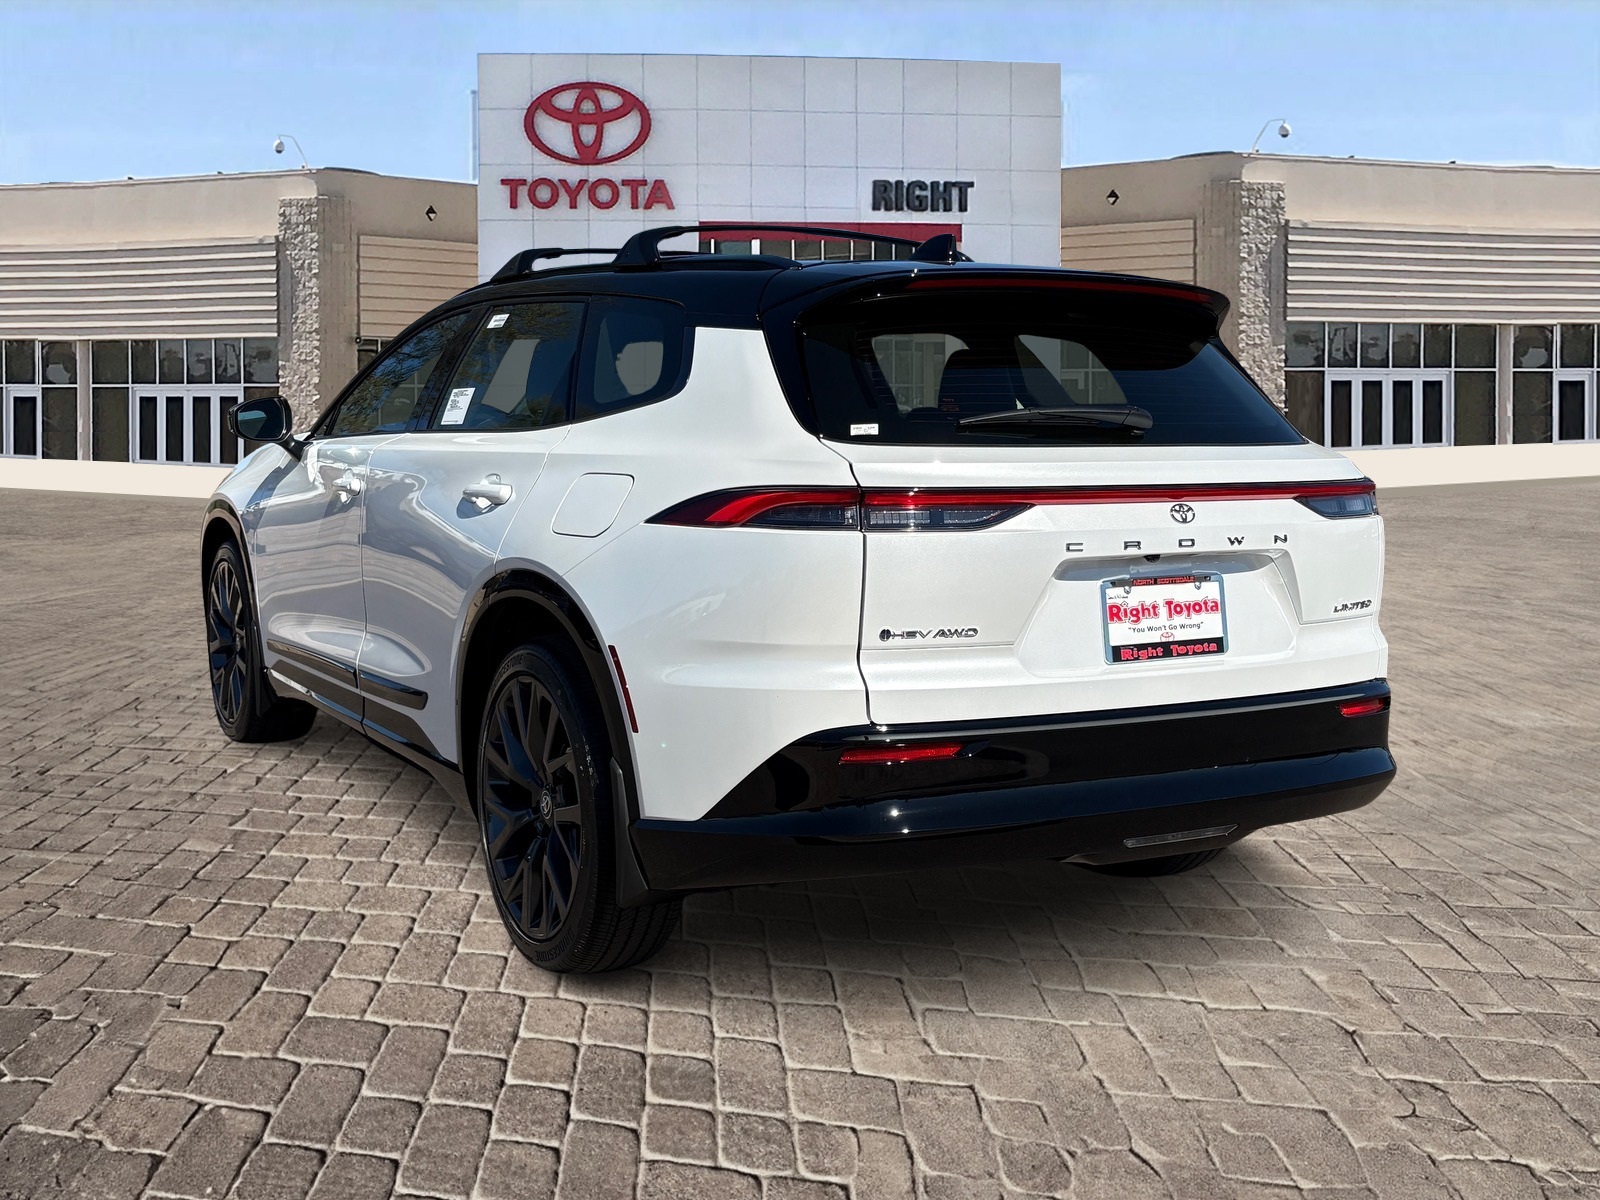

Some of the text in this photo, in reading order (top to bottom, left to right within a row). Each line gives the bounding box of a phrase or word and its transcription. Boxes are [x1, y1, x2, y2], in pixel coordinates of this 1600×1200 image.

[500, 178, 675, 210] TOYOTA
[872, 179, 975, 212] RIGHT
[1065, 534, 1288, 552] CROWN
[1133, 578, 1154, 586] NORTH
[1106, 597, 1221, 625] Right Toyota
[1333, 599, 1372, 613] LIMITED
[1146, 624, 1167, 632] Won't
[1120, 642, 1218, 660] Right Toyota
